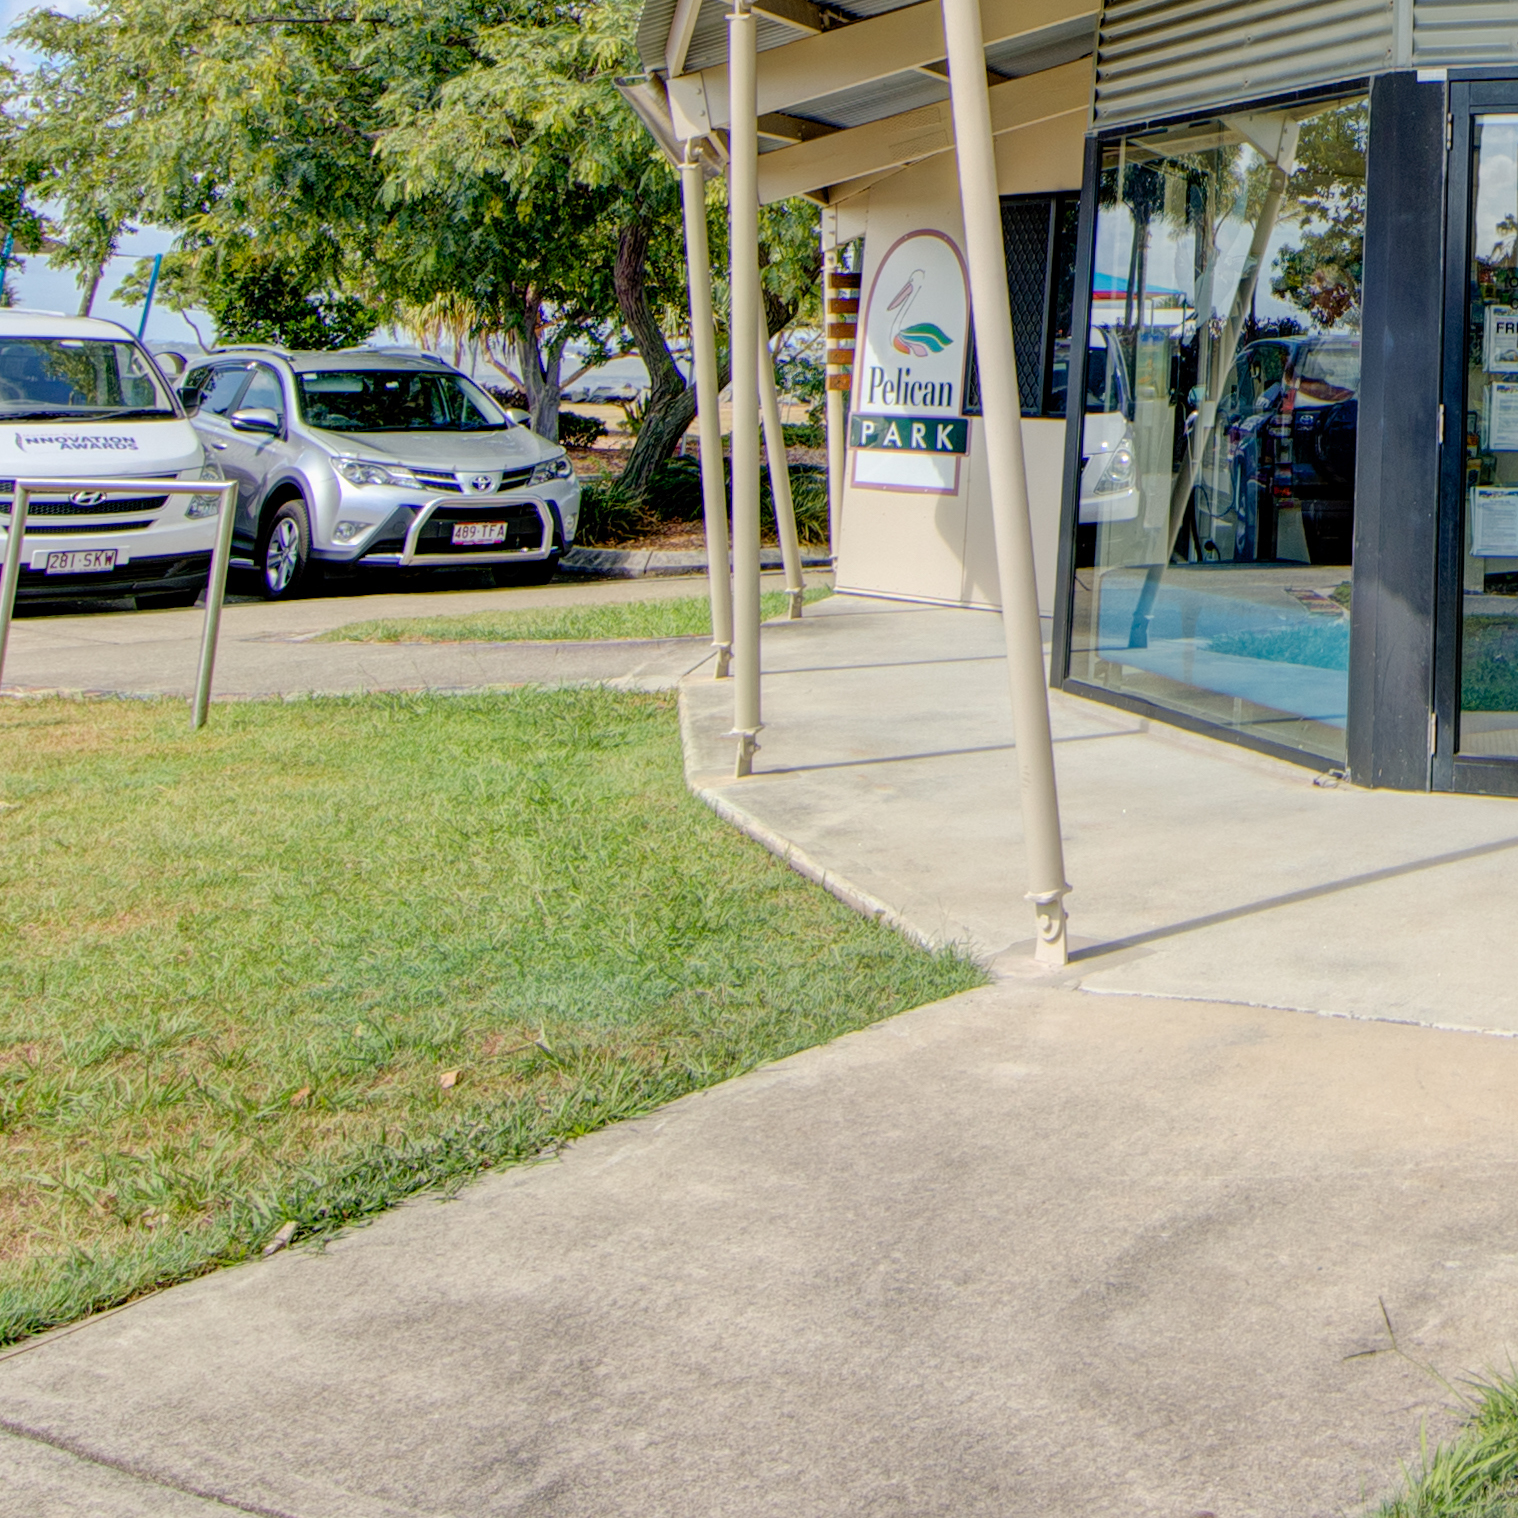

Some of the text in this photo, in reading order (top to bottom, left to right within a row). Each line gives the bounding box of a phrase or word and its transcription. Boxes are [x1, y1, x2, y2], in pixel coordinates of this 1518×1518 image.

[867, 366, 953, 408] Pelican
[59, 442, 139, 451] AWARDS
[860, 420, 954, 451] PARK
